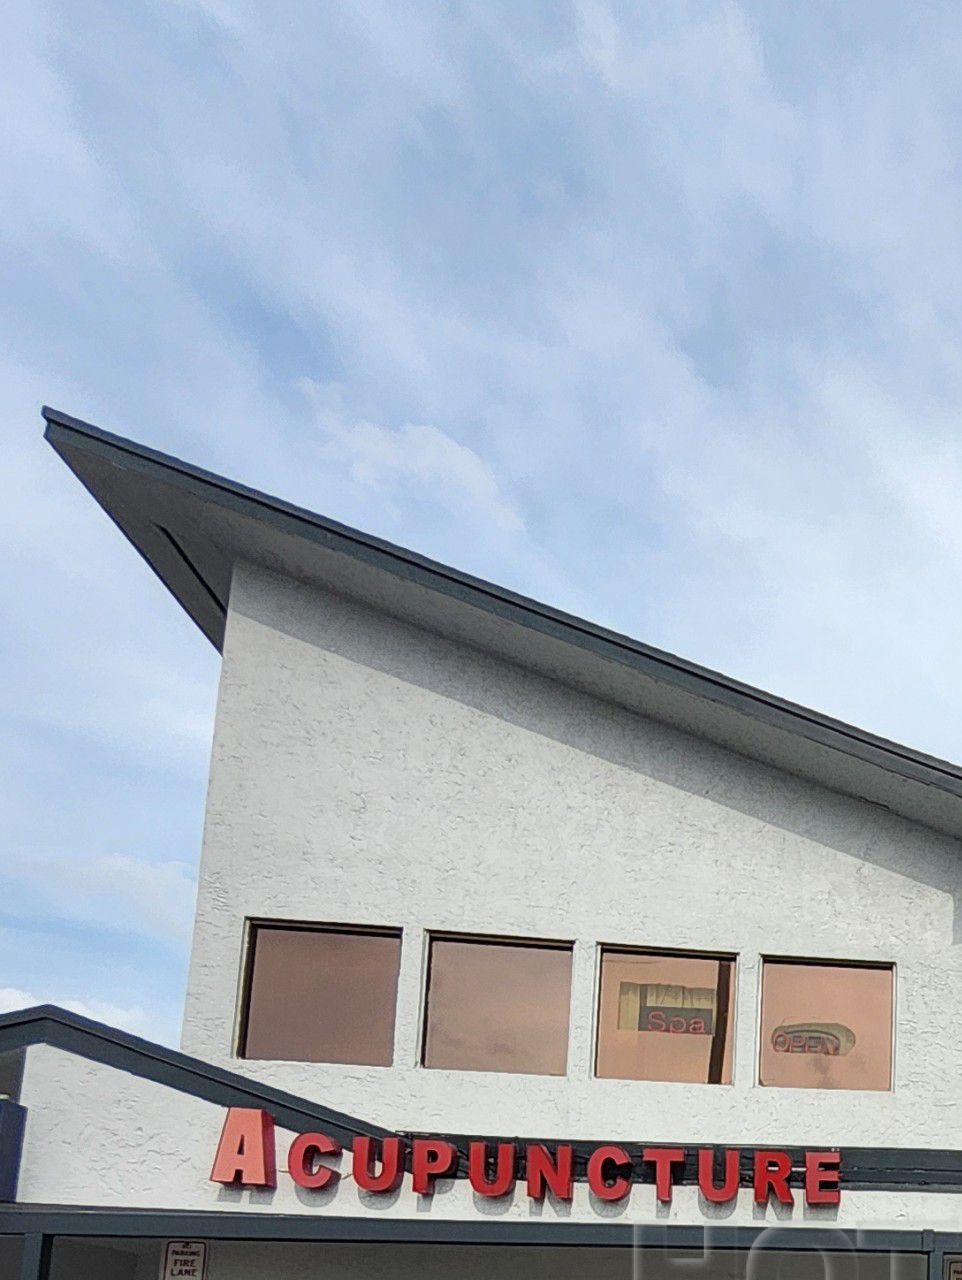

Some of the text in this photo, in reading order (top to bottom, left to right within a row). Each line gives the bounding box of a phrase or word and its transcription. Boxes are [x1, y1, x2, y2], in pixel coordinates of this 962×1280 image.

[648, 1011, 705, 1034] Spa
[210, 1107, 841, 1206] ACUPUNCTURE
[173, 1259, 196, 1267] FIRE
[170, 1268, 197, 1277] LANE
